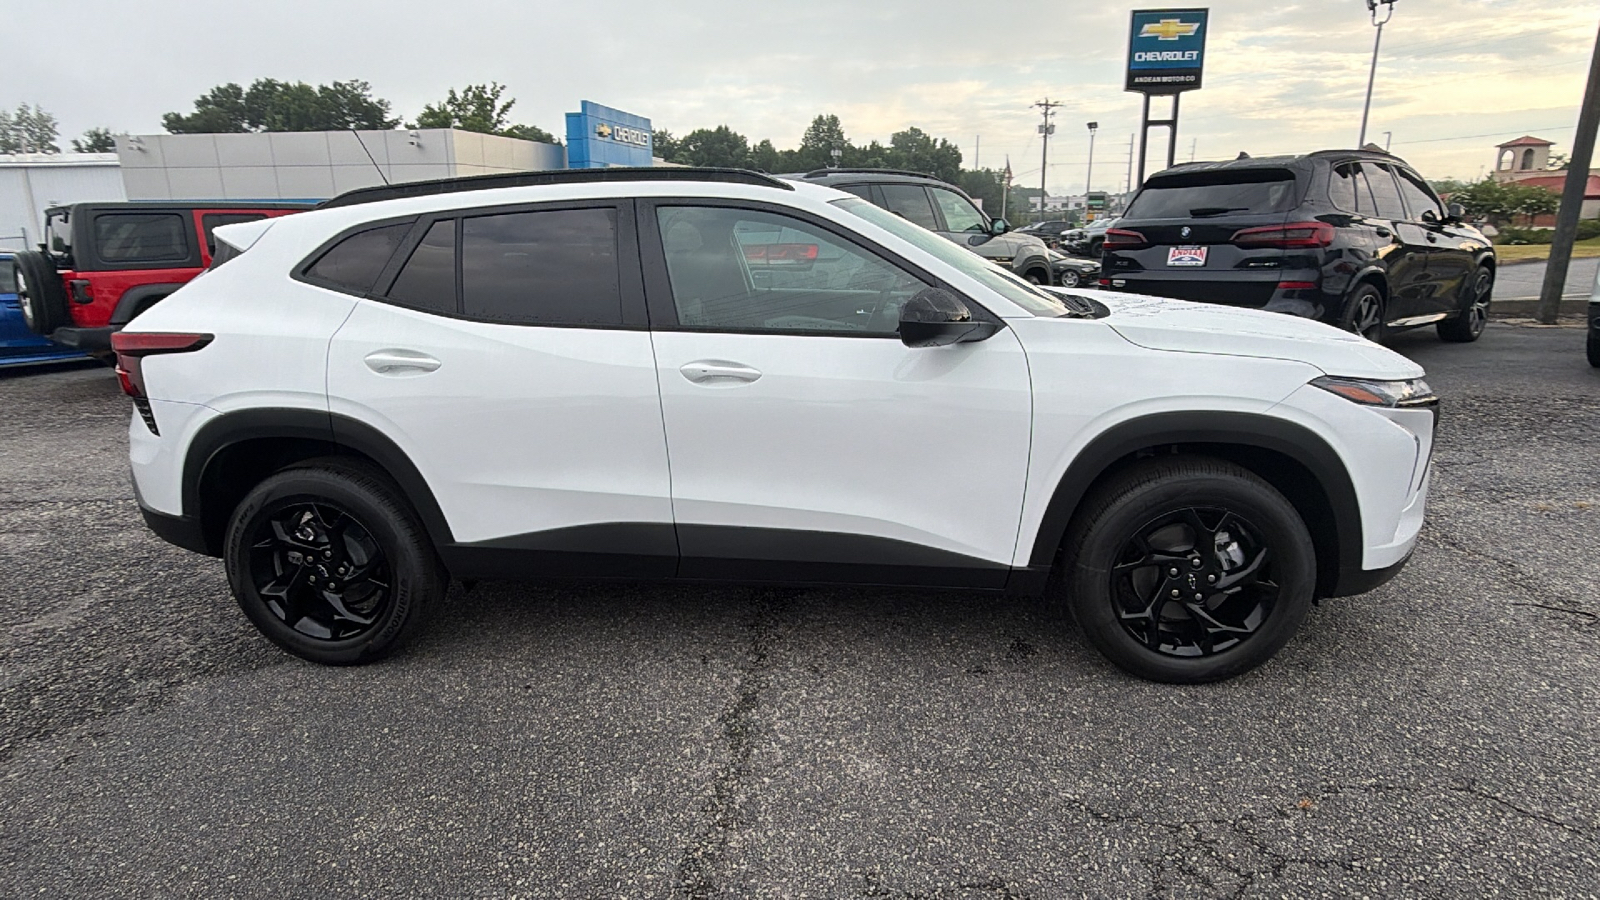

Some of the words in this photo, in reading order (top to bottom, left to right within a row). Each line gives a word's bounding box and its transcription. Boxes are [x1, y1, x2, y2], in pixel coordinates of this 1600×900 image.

[1134, 51, 1199, 61] CHEVROLET
[614, 126, 649, 146] CHEVROLET
[1170, 248, 1204, 259] ANDEAN
